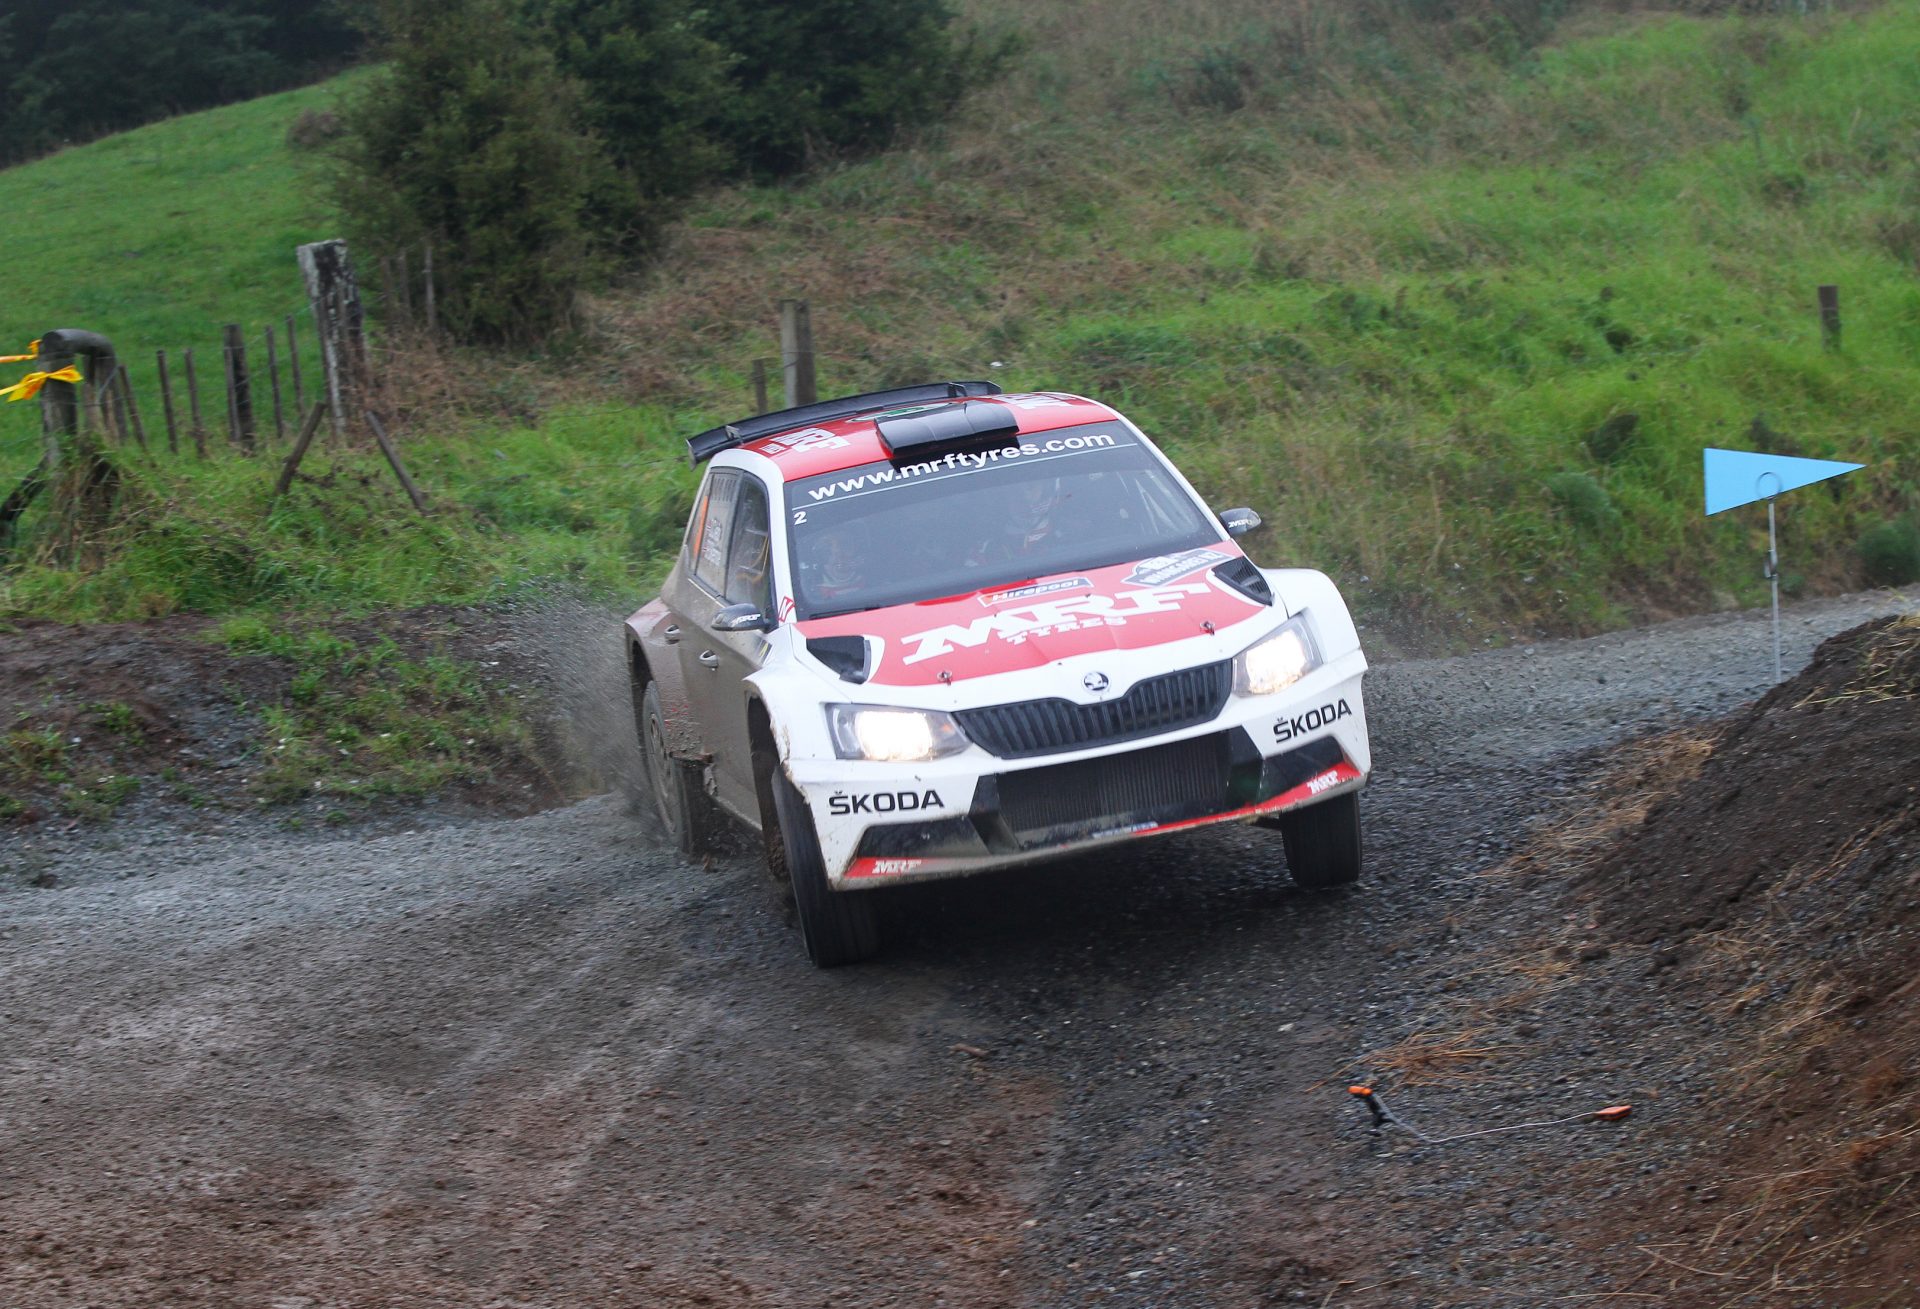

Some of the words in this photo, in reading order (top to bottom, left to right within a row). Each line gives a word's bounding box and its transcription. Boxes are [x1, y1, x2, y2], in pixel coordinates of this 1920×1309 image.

[808, 431, 1115, 501] www.mrftyres.com
[793, 511, 808, 525] 2
[992, 580, 1079, 601] Hirepool
[901, 583, 1212, 666] MRF
[1006, 616, 1127, 645] TYRES
[1272, 698, 1353, 744] ŠKODA
[1306, 770, 1339, 795] MRF
[828, 789, 945, 816] ŠKODA
[871, 859, 922, 875] MRF
